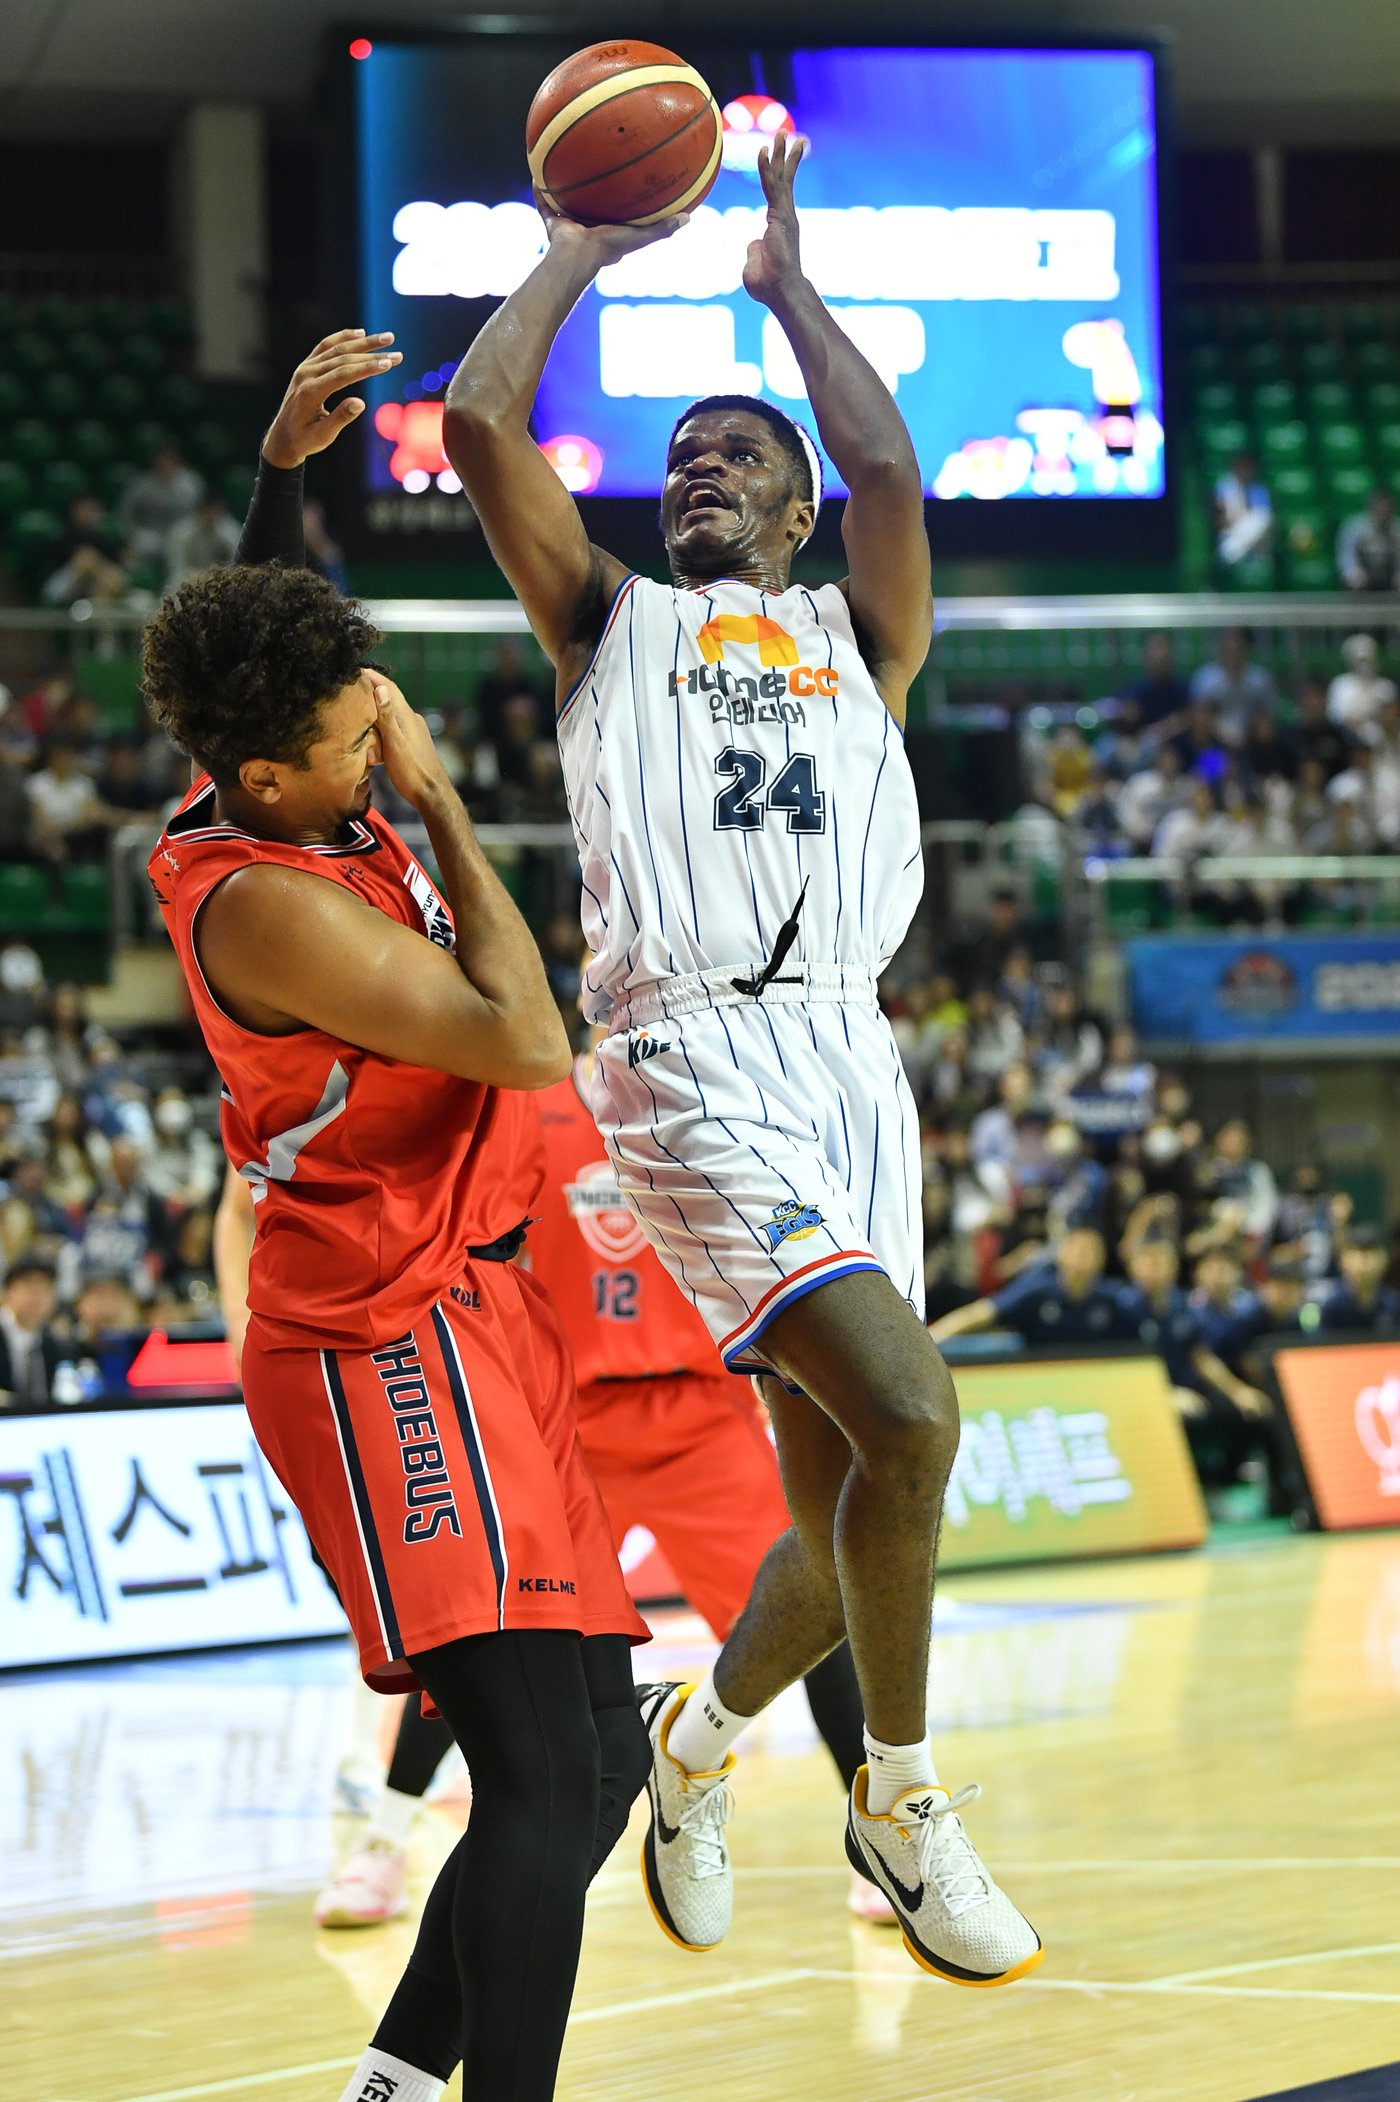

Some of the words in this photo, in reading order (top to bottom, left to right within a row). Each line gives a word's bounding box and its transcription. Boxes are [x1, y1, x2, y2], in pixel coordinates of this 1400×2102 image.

[713, 745, 826, 835] 24
[758, 1204, 827, 1255] EGIS
[774, 1200, 800, 1218] KCC
[594, 1270, 640, 1320] 12
[0, 1437, 298, 1623] 제스파
[518, 1577, 577, 1596] KELME
[356, 2070, 399, 2102] KE
